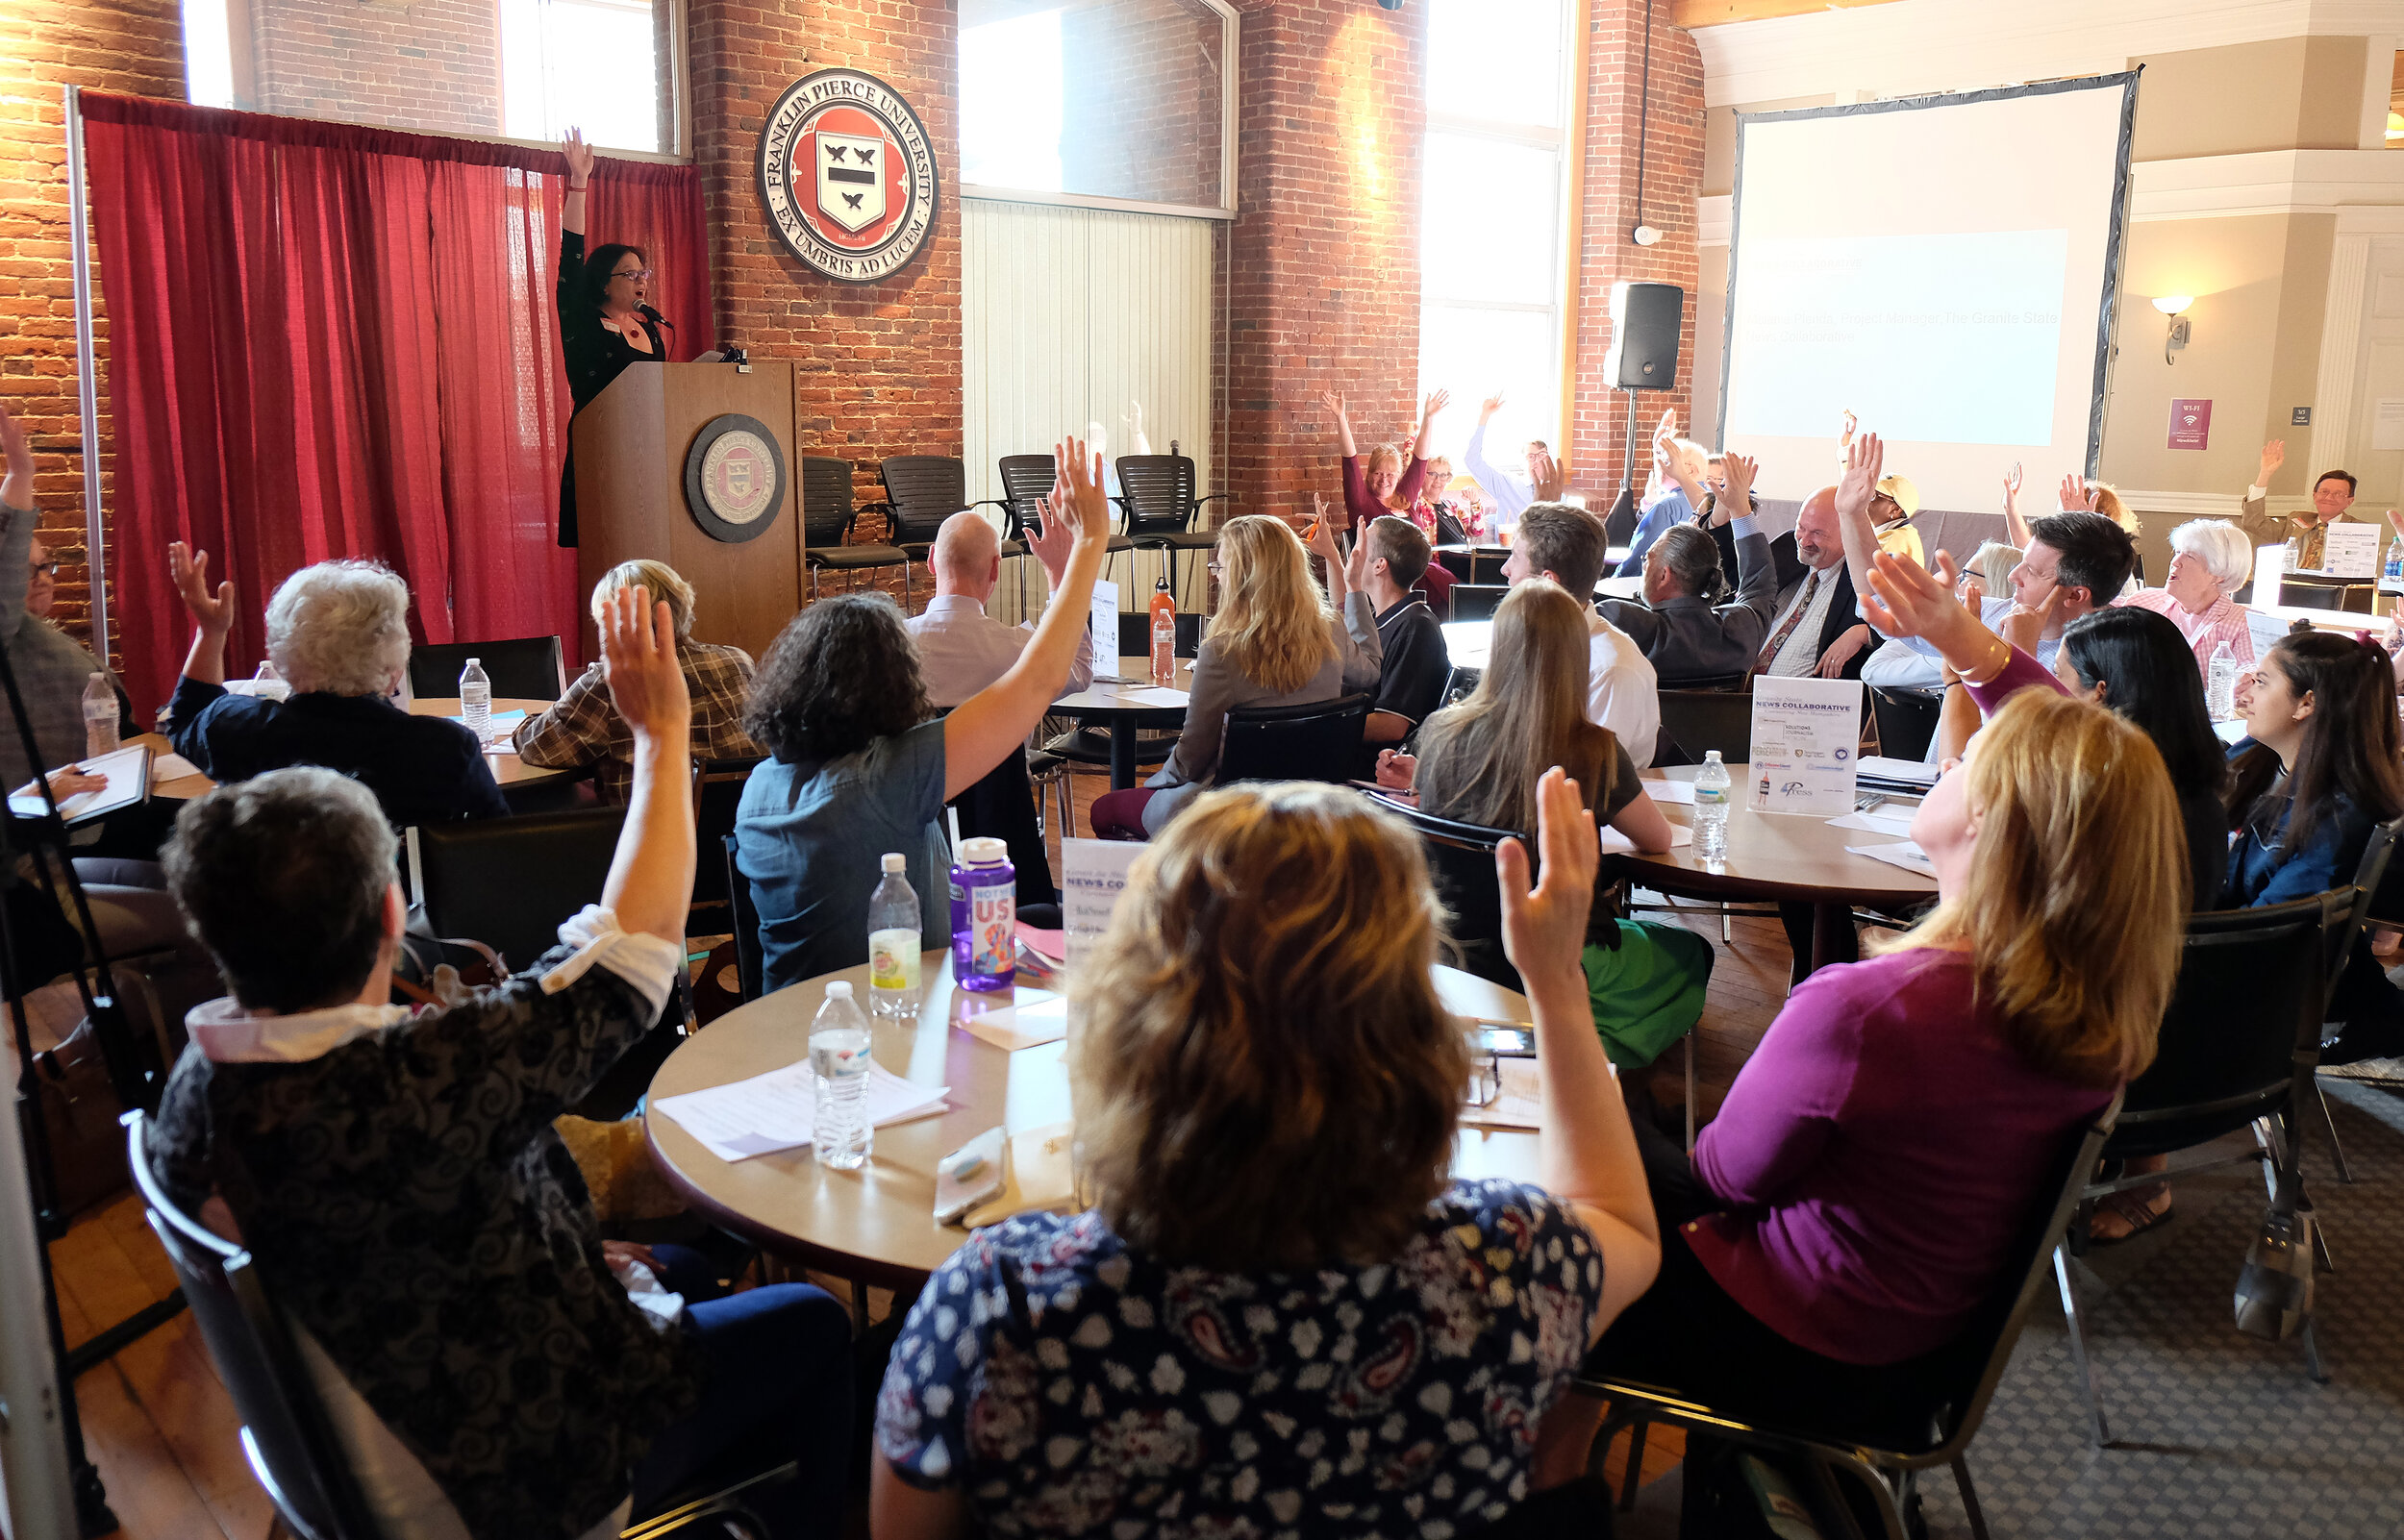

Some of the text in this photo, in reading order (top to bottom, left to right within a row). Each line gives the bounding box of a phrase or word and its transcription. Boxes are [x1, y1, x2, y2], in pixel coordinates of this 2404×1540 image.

[768, 80, 931, 207] FRANKLIN PIERCE UNIVERSITY
[776, 206, 923, 275] EX UMBRIS AD LUCEM
[1971, 310, 2019, 324] Granite
[2022, 310, 2058, 324] State
[1782, 703, 1851, 711] COLLABORATIVE
[1066, 878, 1103, 887] NEWS
[975, 889, 999, 898] NOT
[976, 899, 1010, 923] US
